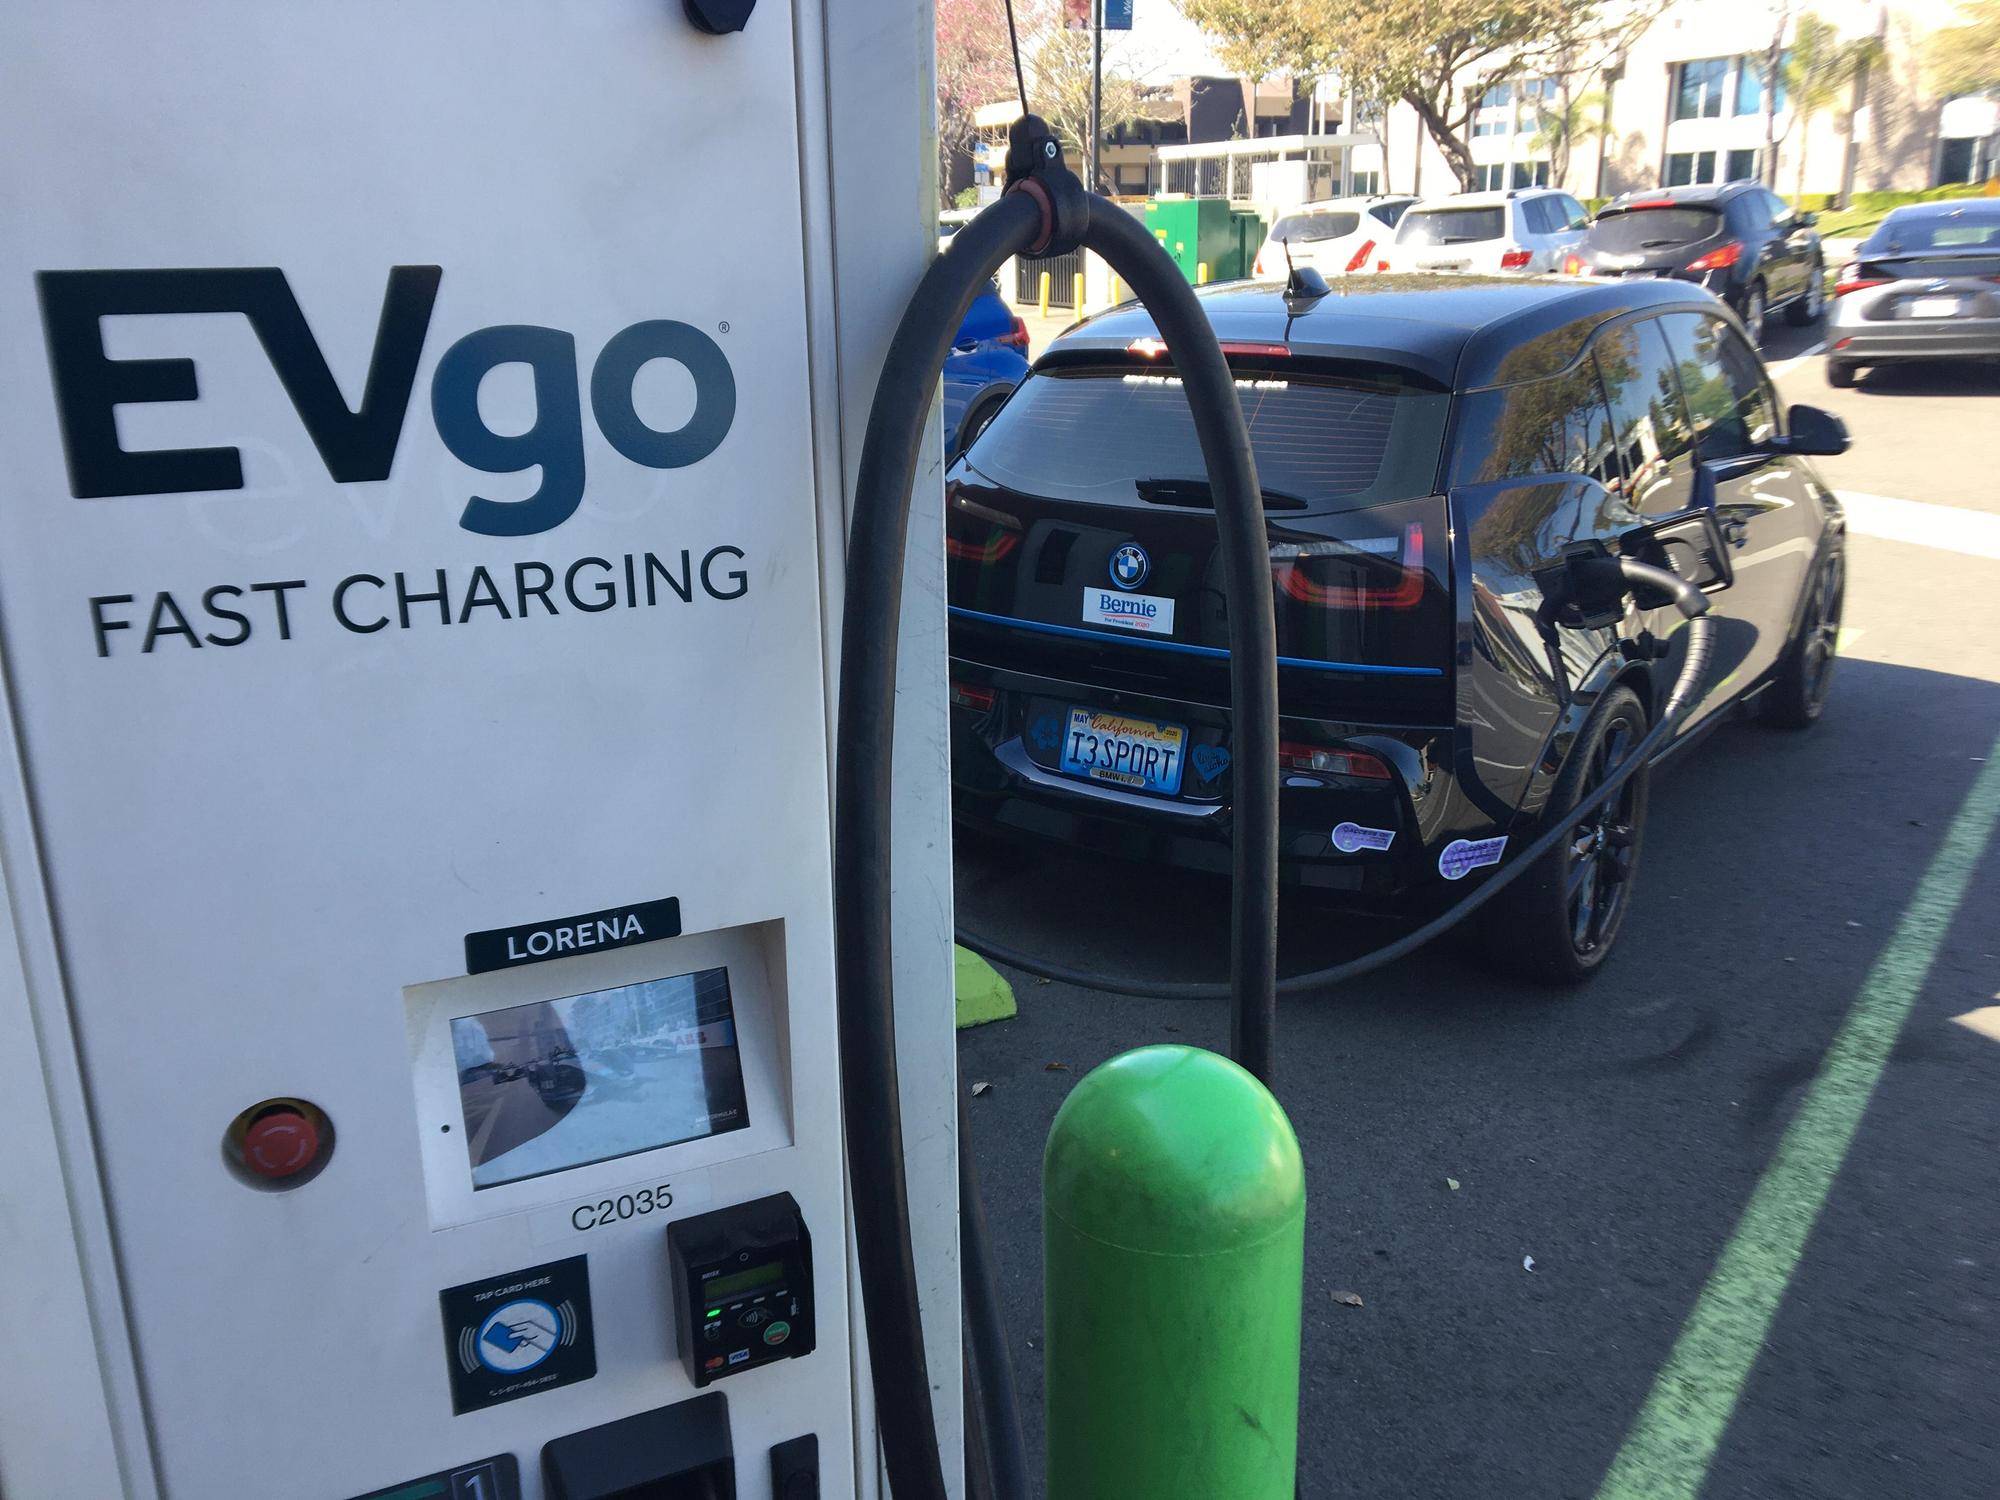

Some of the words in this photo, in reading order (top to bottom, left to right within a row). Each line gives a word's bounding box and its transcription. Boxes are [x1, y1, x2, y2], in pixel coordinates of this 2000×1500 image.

[89, 579, 306, 658] FAST
[331, 545, 749, 635] CHARGING
[1100, 593, 1157, 618] Bernie
[1073, 713, 1089, 724] MAY
[1089, 714, 1161, 741] California
[1068, 731, 1176, 782] I3SPORT
[1099, 771, 1119, 781] BMW
[507, 914, 645, 960] LORENA
[571, 1183, 674, 1232] C2035
[473, 1290, 494, 1302] TAP
[494, 1282, 524, 1298] CARD
[524, 1275, 552, 1289] HERE
